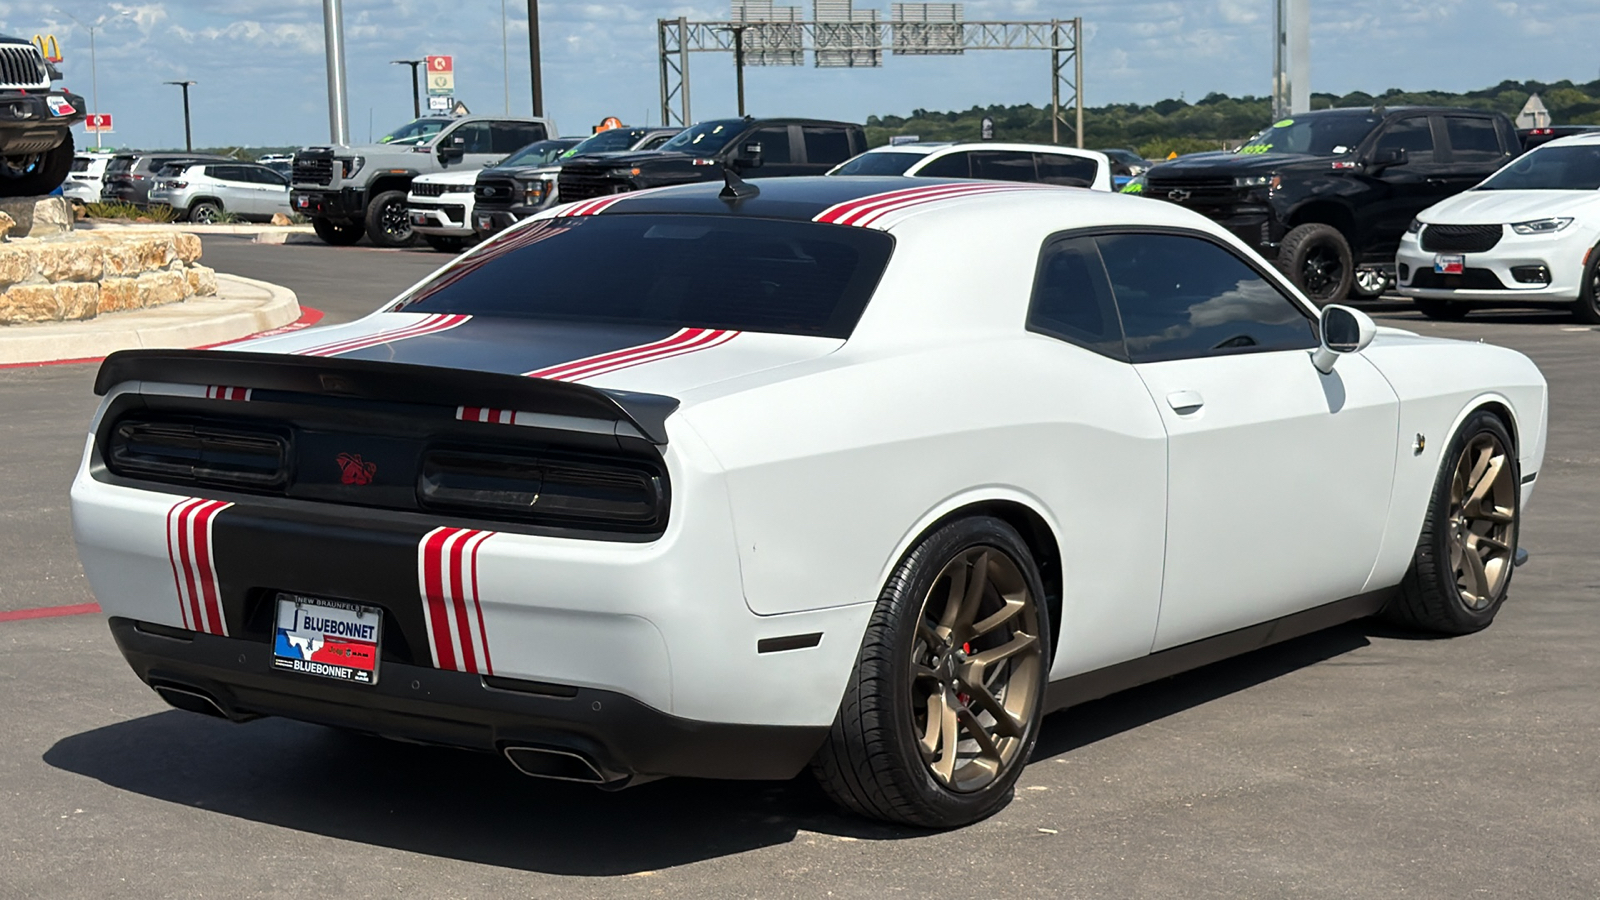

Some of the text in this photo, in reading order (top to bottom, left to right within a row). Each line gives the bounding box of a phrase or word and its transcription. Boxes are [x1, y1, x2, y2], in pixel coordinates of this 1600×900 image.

[316, 599, 360, 612] BRAUNFELS
[303, 616, 375, 640] BLUEBONNET
[293, 660, 353, 679] BLUEBONNET
